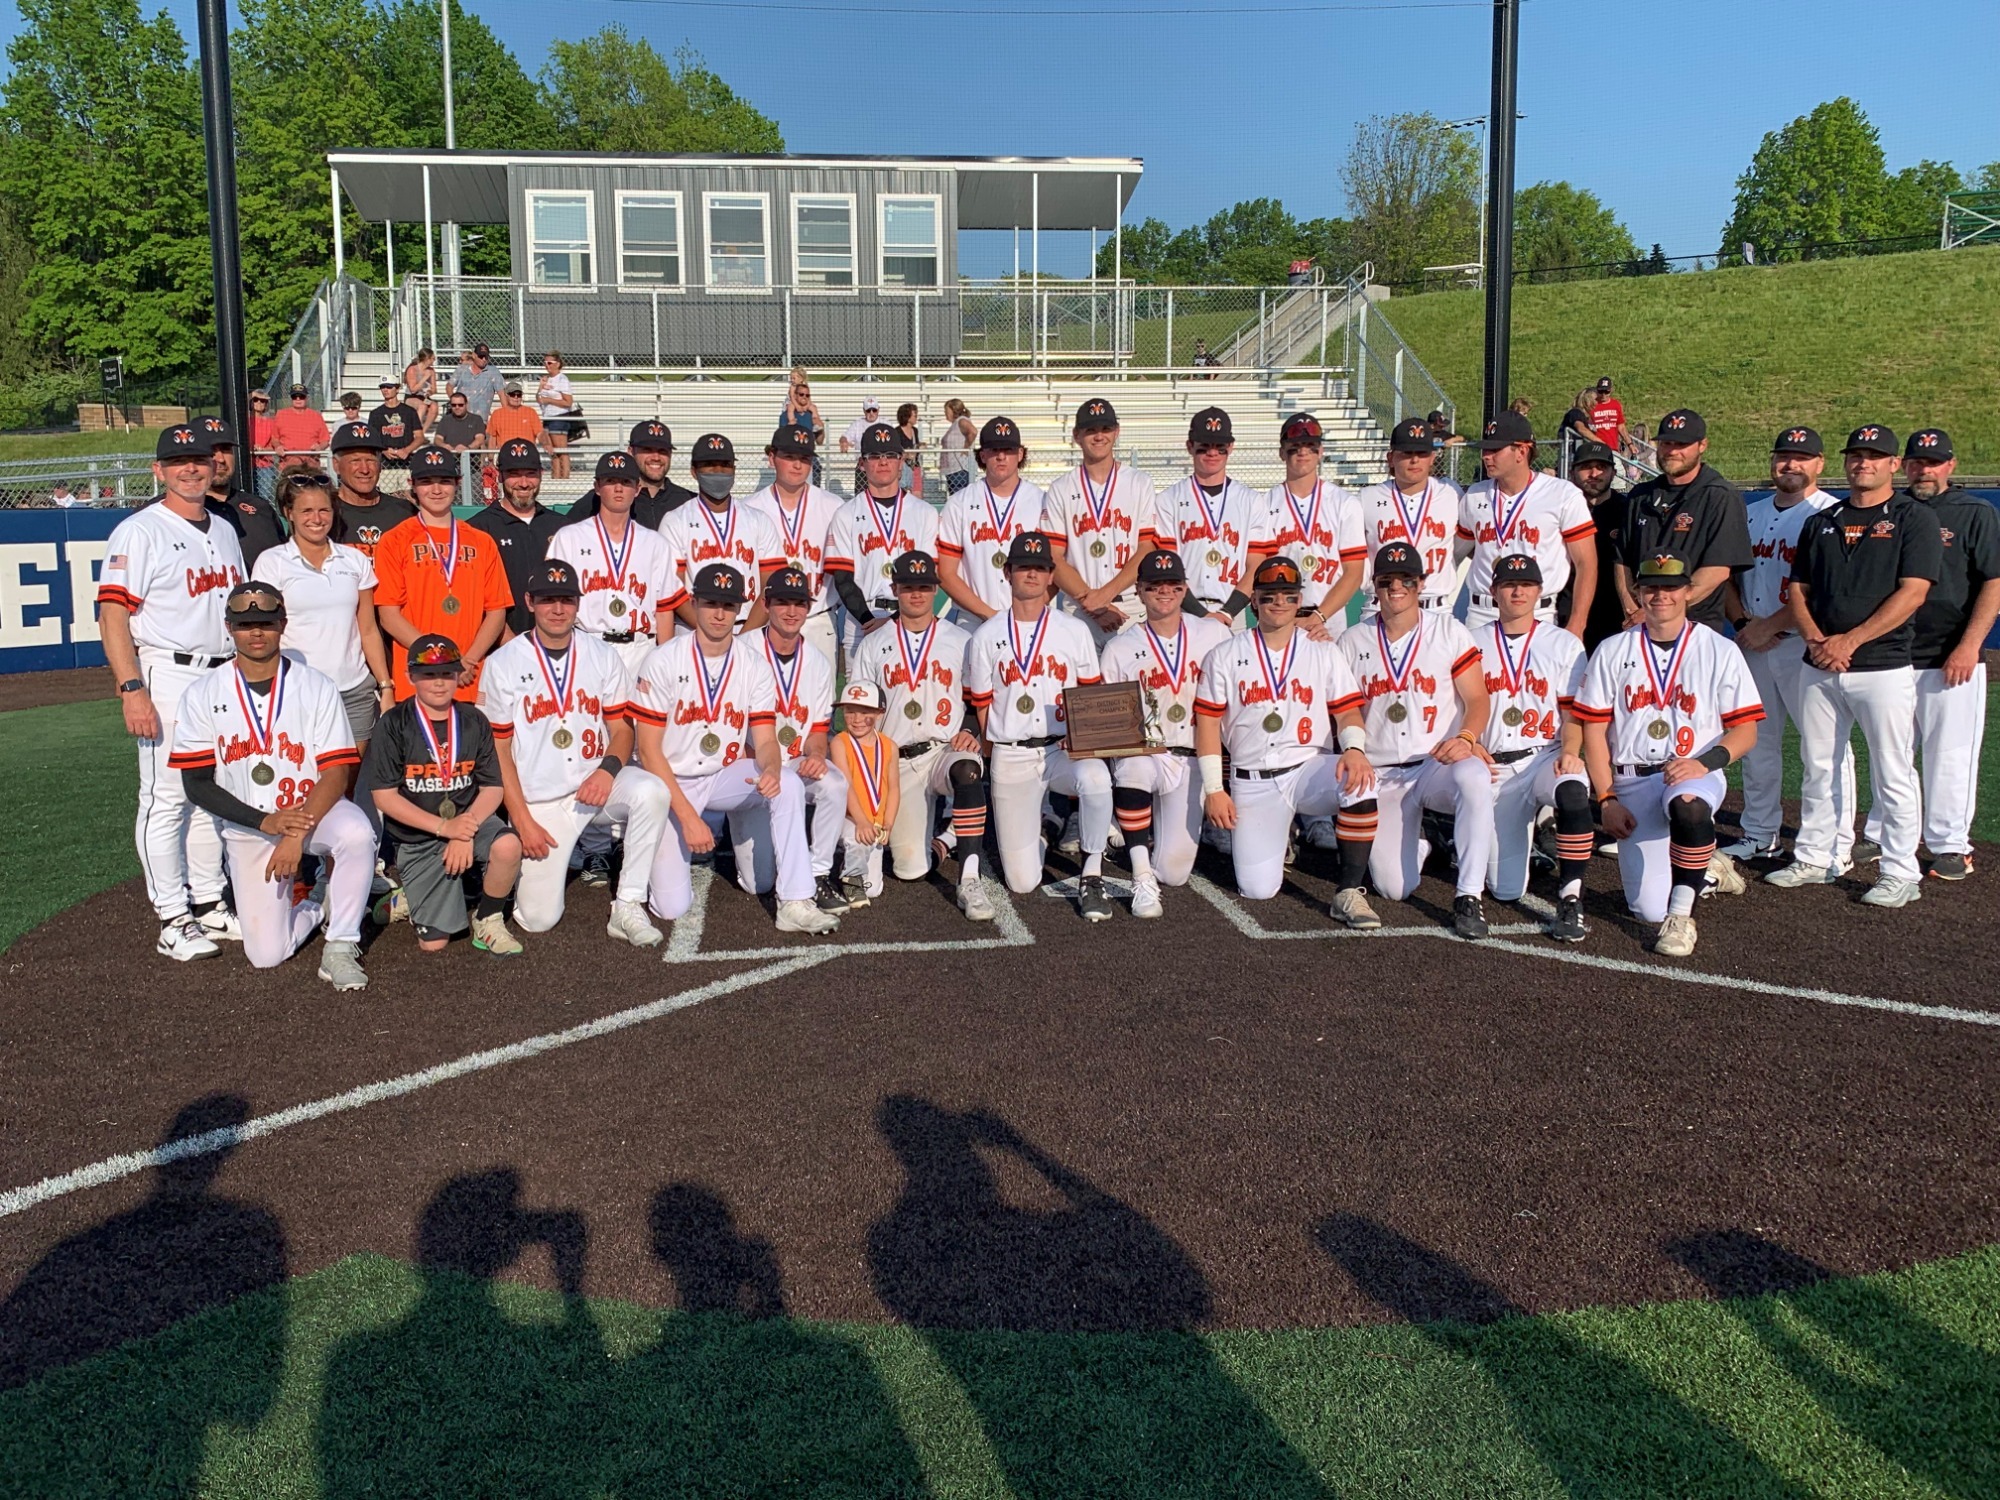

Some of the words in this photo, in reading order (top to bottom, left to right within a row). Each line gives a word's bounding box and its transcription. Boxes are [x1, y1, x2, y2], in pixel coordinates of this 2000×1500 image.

[970, 520, 1012, 545] Cathedl
[1072, 508, 1112, 538] Catheal
[1113, 508, 1132, 538] Prep
[1179, 520, 1219, 544] Cathed
[1222, 521, 1240, 553] Prep
[1377, 519, 1409, 545] Cathed
[1475, 520, 1516, 546] Cathel
[1519, 519, 1540, 550] Prep
[413, 543, 477, 563] PRP
[691, 538, 733, 562] Cathedl
[735, 539, 754, 570] Prep
[858, 530, 898, 556] Cathed
[1218, 557, 1240, 586] 14
[1311, 556, 1339, 585] 27
[1425, 548, 1447, 575] 17
[581, 568, 625, 594] Cathedl
[629, 572, 648, 606] Prep
[883, 662, 929, 690] Cathel
[931, 659, 953, 693] Prep
[998, 654, 1045, 688] Cathal
[1046, 654, 1068, 687] Prep
[1139, 666, 1188, 694] Cathe
[1360, 673, 1409, 700] Cathed
[1411, 668, 1437, 699] Prep
[1524, 669, 1549, 704] Prep
[523, 691, 574, 724] Cathel
[575, 688, 601, 722] Prep
[1239, 680, 1288, 707] Cathedl
[1291, 677, 1313, 711] Prep
[1624, 684, 1674, 714] Cathed
[1674, 683, 1697, 721] Prep
[674, 699, 720, 726] Cathed
[723, 701, 745, 735] Prep
[935, 698, 952, 727] 2
[1423, 705, 1438, 733] 7
[1520, 708, 1556, 740] 24
[1297, 716, 1313, 745] 6
[1675, 725, 1695, 757] 9
[218, 732, 273, 766] Cathedl
[277, 731, 305, 772] Prep
[722, 741, 740, 767] 8
[787, 735, 803, 761] 4
